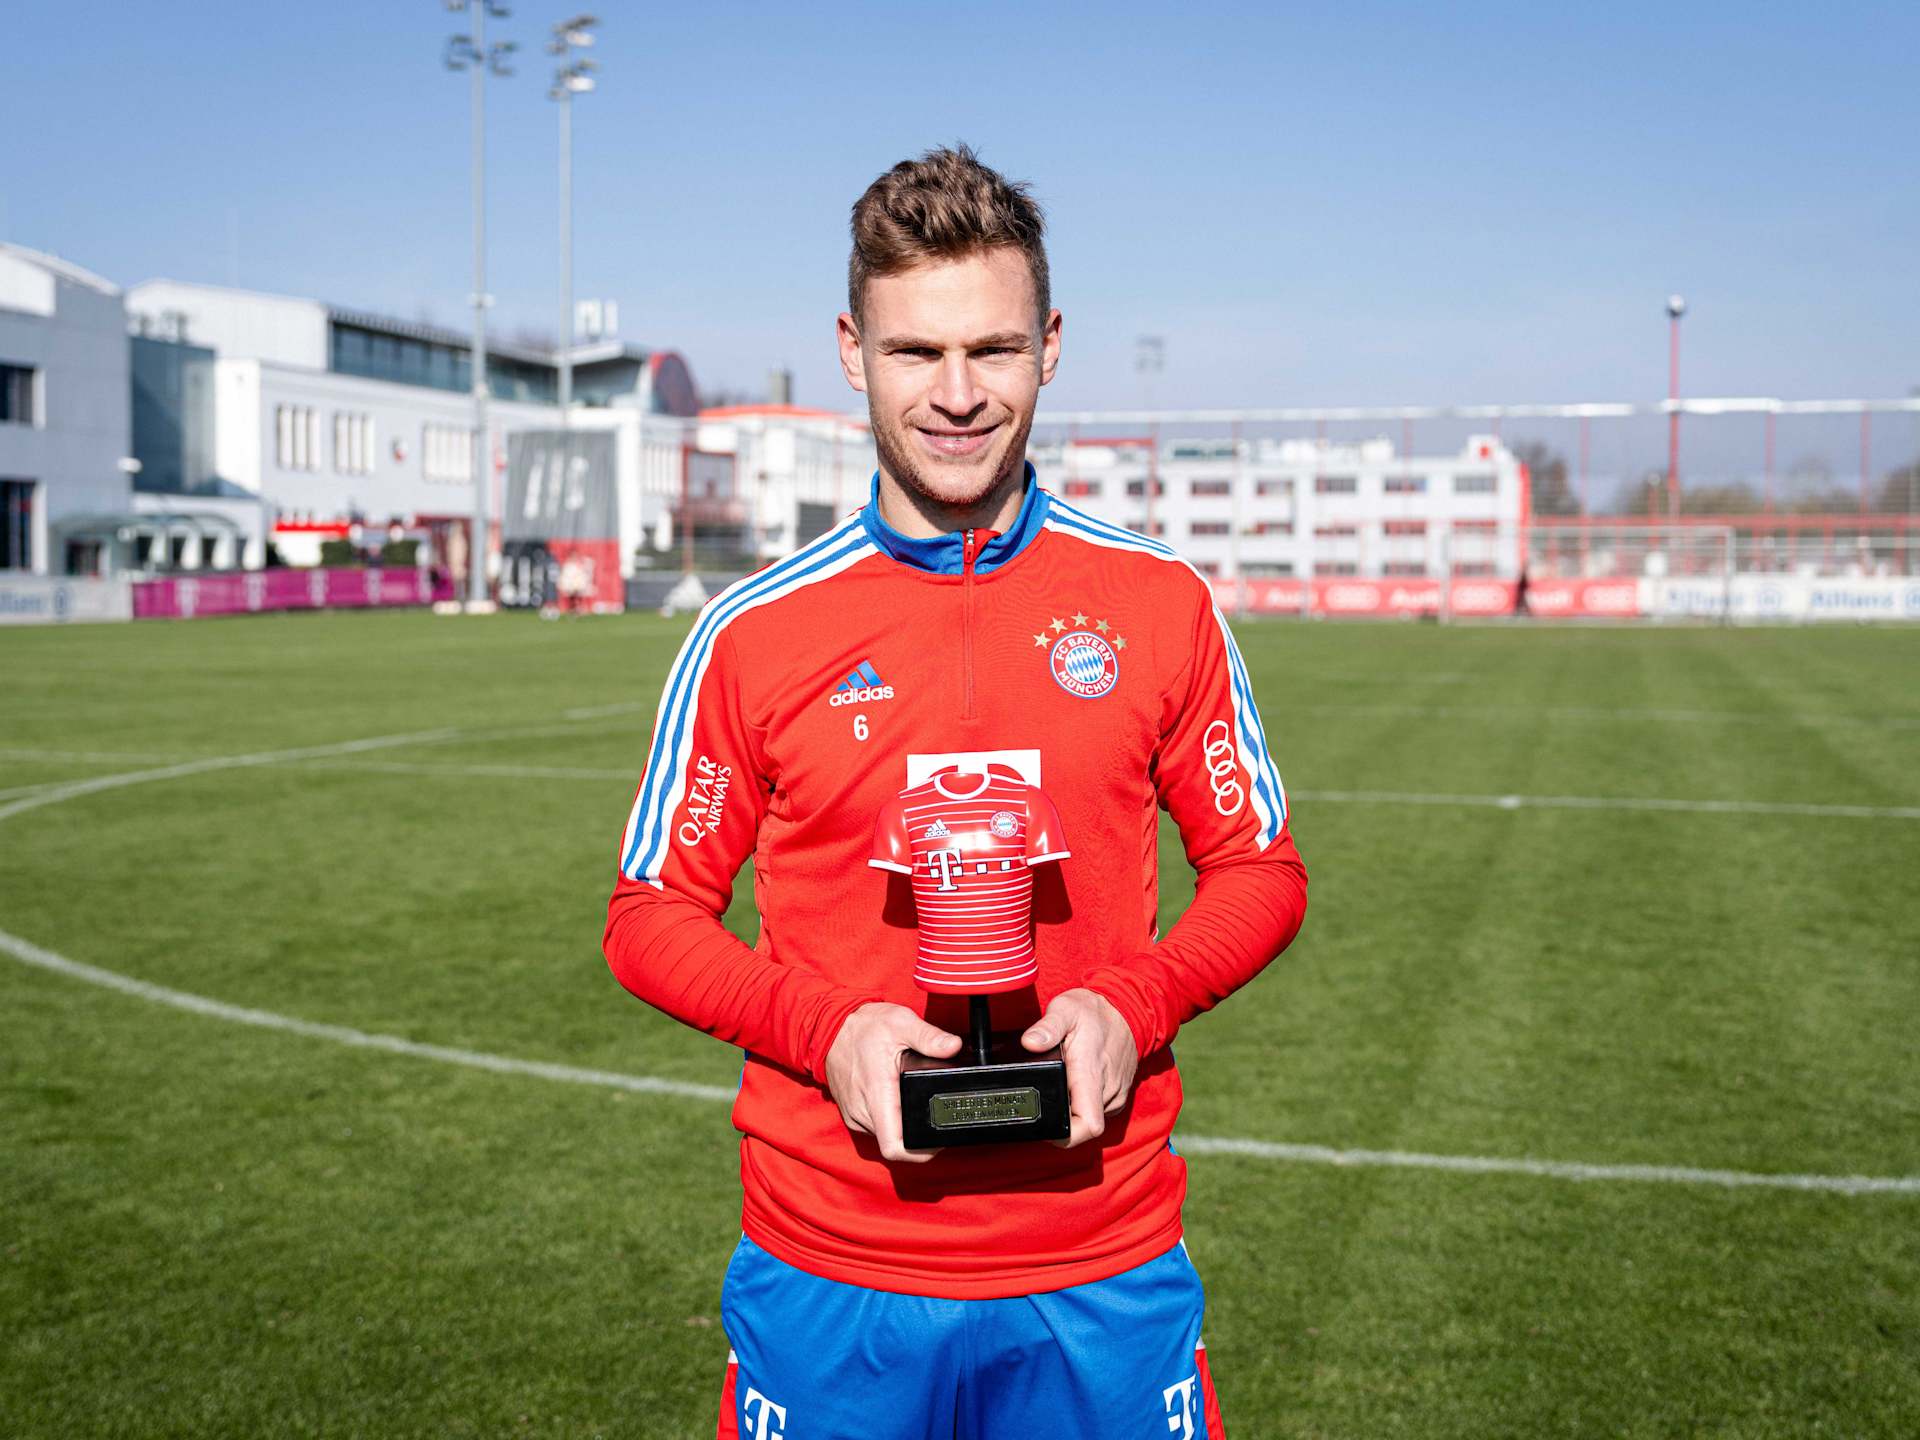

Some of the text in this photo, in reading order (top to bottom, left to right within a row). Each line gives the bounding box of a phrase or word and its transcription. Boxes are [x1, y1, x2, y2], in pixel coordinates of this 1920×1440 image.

[1055, 635, 1113, 662] FC BAYERN
[1057, 670, 1114, 695] MÜNCHEN
[829, 686, 895, 707] adidas
[853, 714, 869, 741] 6
[678, 755, 717, 847] QATAR
[705, 765, 732, 833] AIRWAYS
